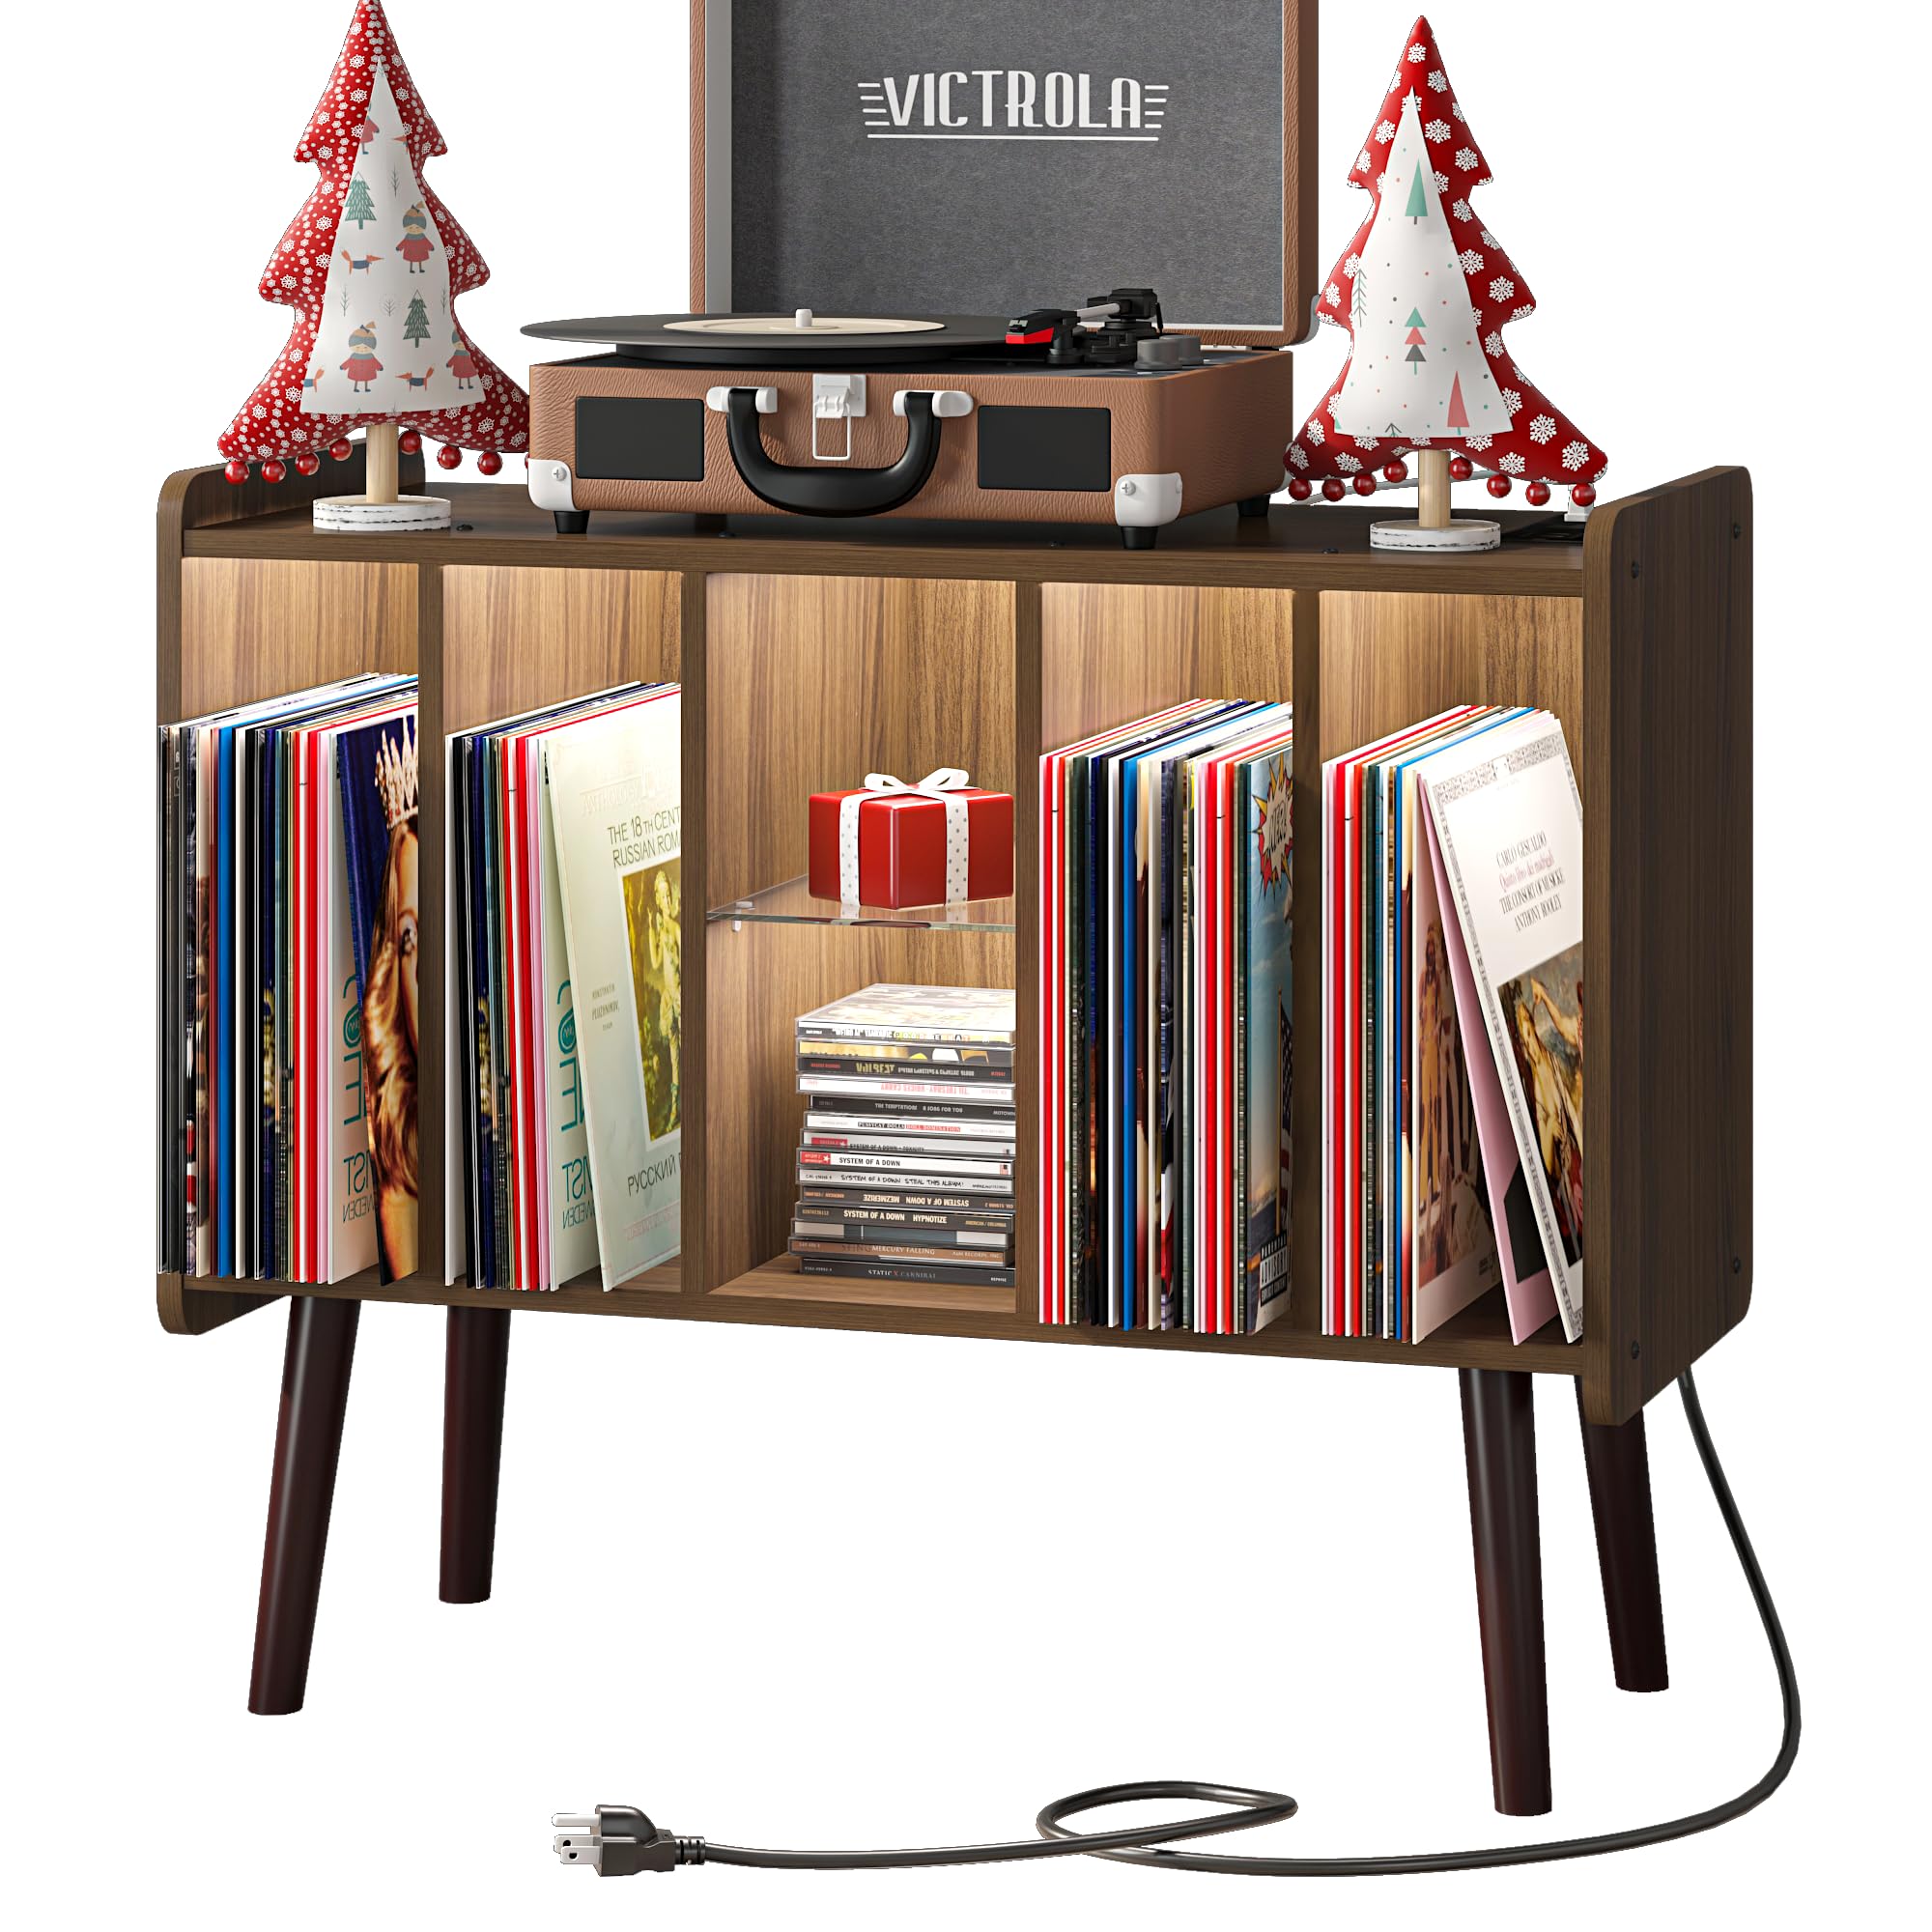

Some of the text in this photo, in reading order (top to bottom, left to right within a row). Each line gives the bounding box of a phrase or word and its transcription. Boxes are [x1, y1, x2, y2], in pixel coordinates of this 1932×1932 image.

[883, 70, 1141, 128] VICTROLA
[608, 822, 629, 845] THE
[612, 830, 681, 869] RUSSIAN ROM
[1496, 844, 1517, 867] CARLO
[1499, 895, 1513, 915] THE
[1511, 881, 1536, 908] CONSORT
[1514, 903, 1541, 933] ANTHONY
[838, 1156, 864, 1165] SYSTEM
[627, 1153, 677, 1197] РУССКИЙ
[863, 1193, 900, 1204] MEZMERIZE
[905, 1196, 925, 1206] DOWN
[926, 1197, 931, 1206] A
[944, 1198, 970, 1208] SYSTEM
[844, 1209, 948, 1224] SYSTEM OF A DOWN HYPNOTIZE
[906, 1246, 935, 1256] FALLING
